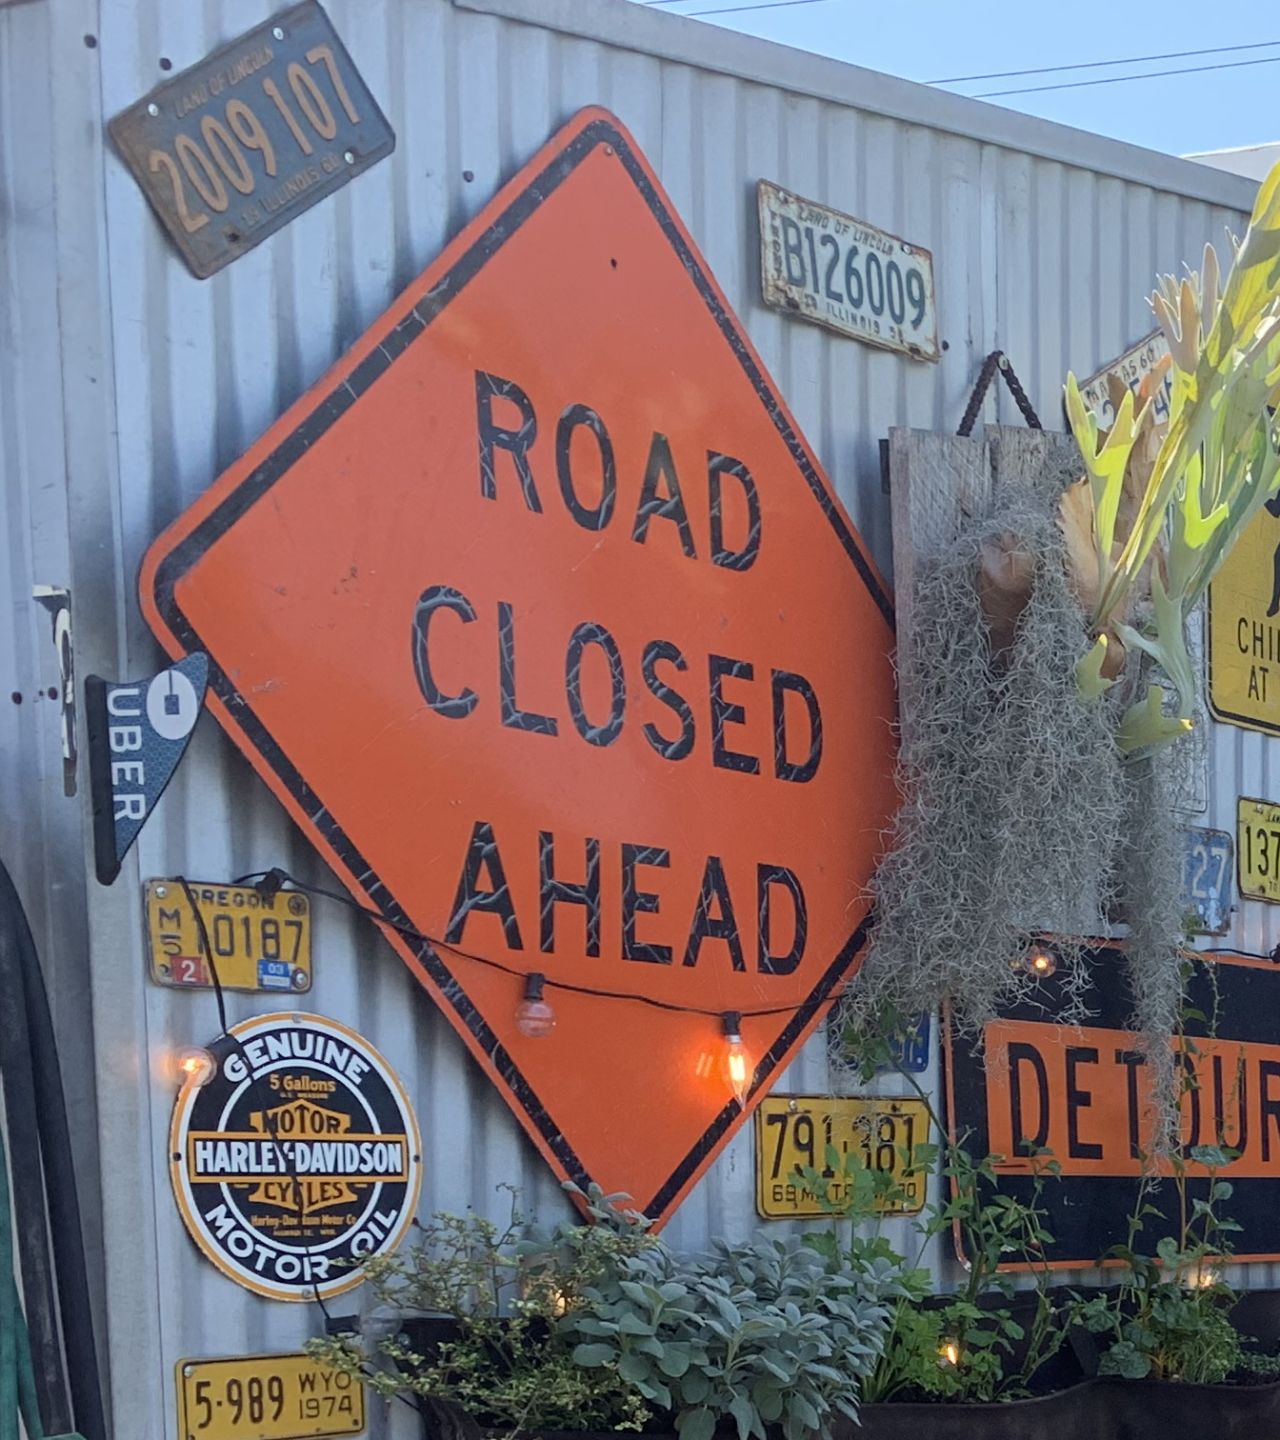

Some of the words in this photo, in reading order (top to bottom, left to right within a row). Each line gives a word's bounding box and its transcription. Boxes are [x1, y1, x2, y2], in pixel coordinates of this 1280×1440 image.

[175, 85, 209, 119] LAND
[208, 75, 227, 96] OF
[226, 45, 274, 87] LINCOLN
[150, 98, 277, 233] 2009
[262, 44, 360, 155] 107
[259, 167, 321, 213] ILLINOIS
[798, 206, 829, 230] LAND
[834, 220, 850, 238] OF
[853, 227, 894, 257] LINCOLN
[780, 214, 927, 332] B126009
[826, 303, 882, 335] ILLINOIS
[473, 369, 763, 572] ROAD
[410, 584, 824, 785] CLOSED
[1247, 665, 1269, 704] AT
[106, 687, 147, 821] UBER
[1182, 844, 1229, 899] 27
[443, 820, 809, 977] AHEAD
[181, 959, 198, 983] 2
[267, 963, 285, 976] 03
[223, 1031, 371, 1086] GENUINE
[269, 1073, 280, 1090] 5
[282, 1074, 337, 1093] Gallons
[261, 1102, 341, 1134] MOTOR
[195, 1140, 403, 1174] HARLEY-DAVIDSON
[204, 1203, 330, 1282] MOTOR
[350, 1208, 399, 1259] OIL
[297, 1369, 353, 1394] WYO
[298, 1395, 354, 1421] 1974
